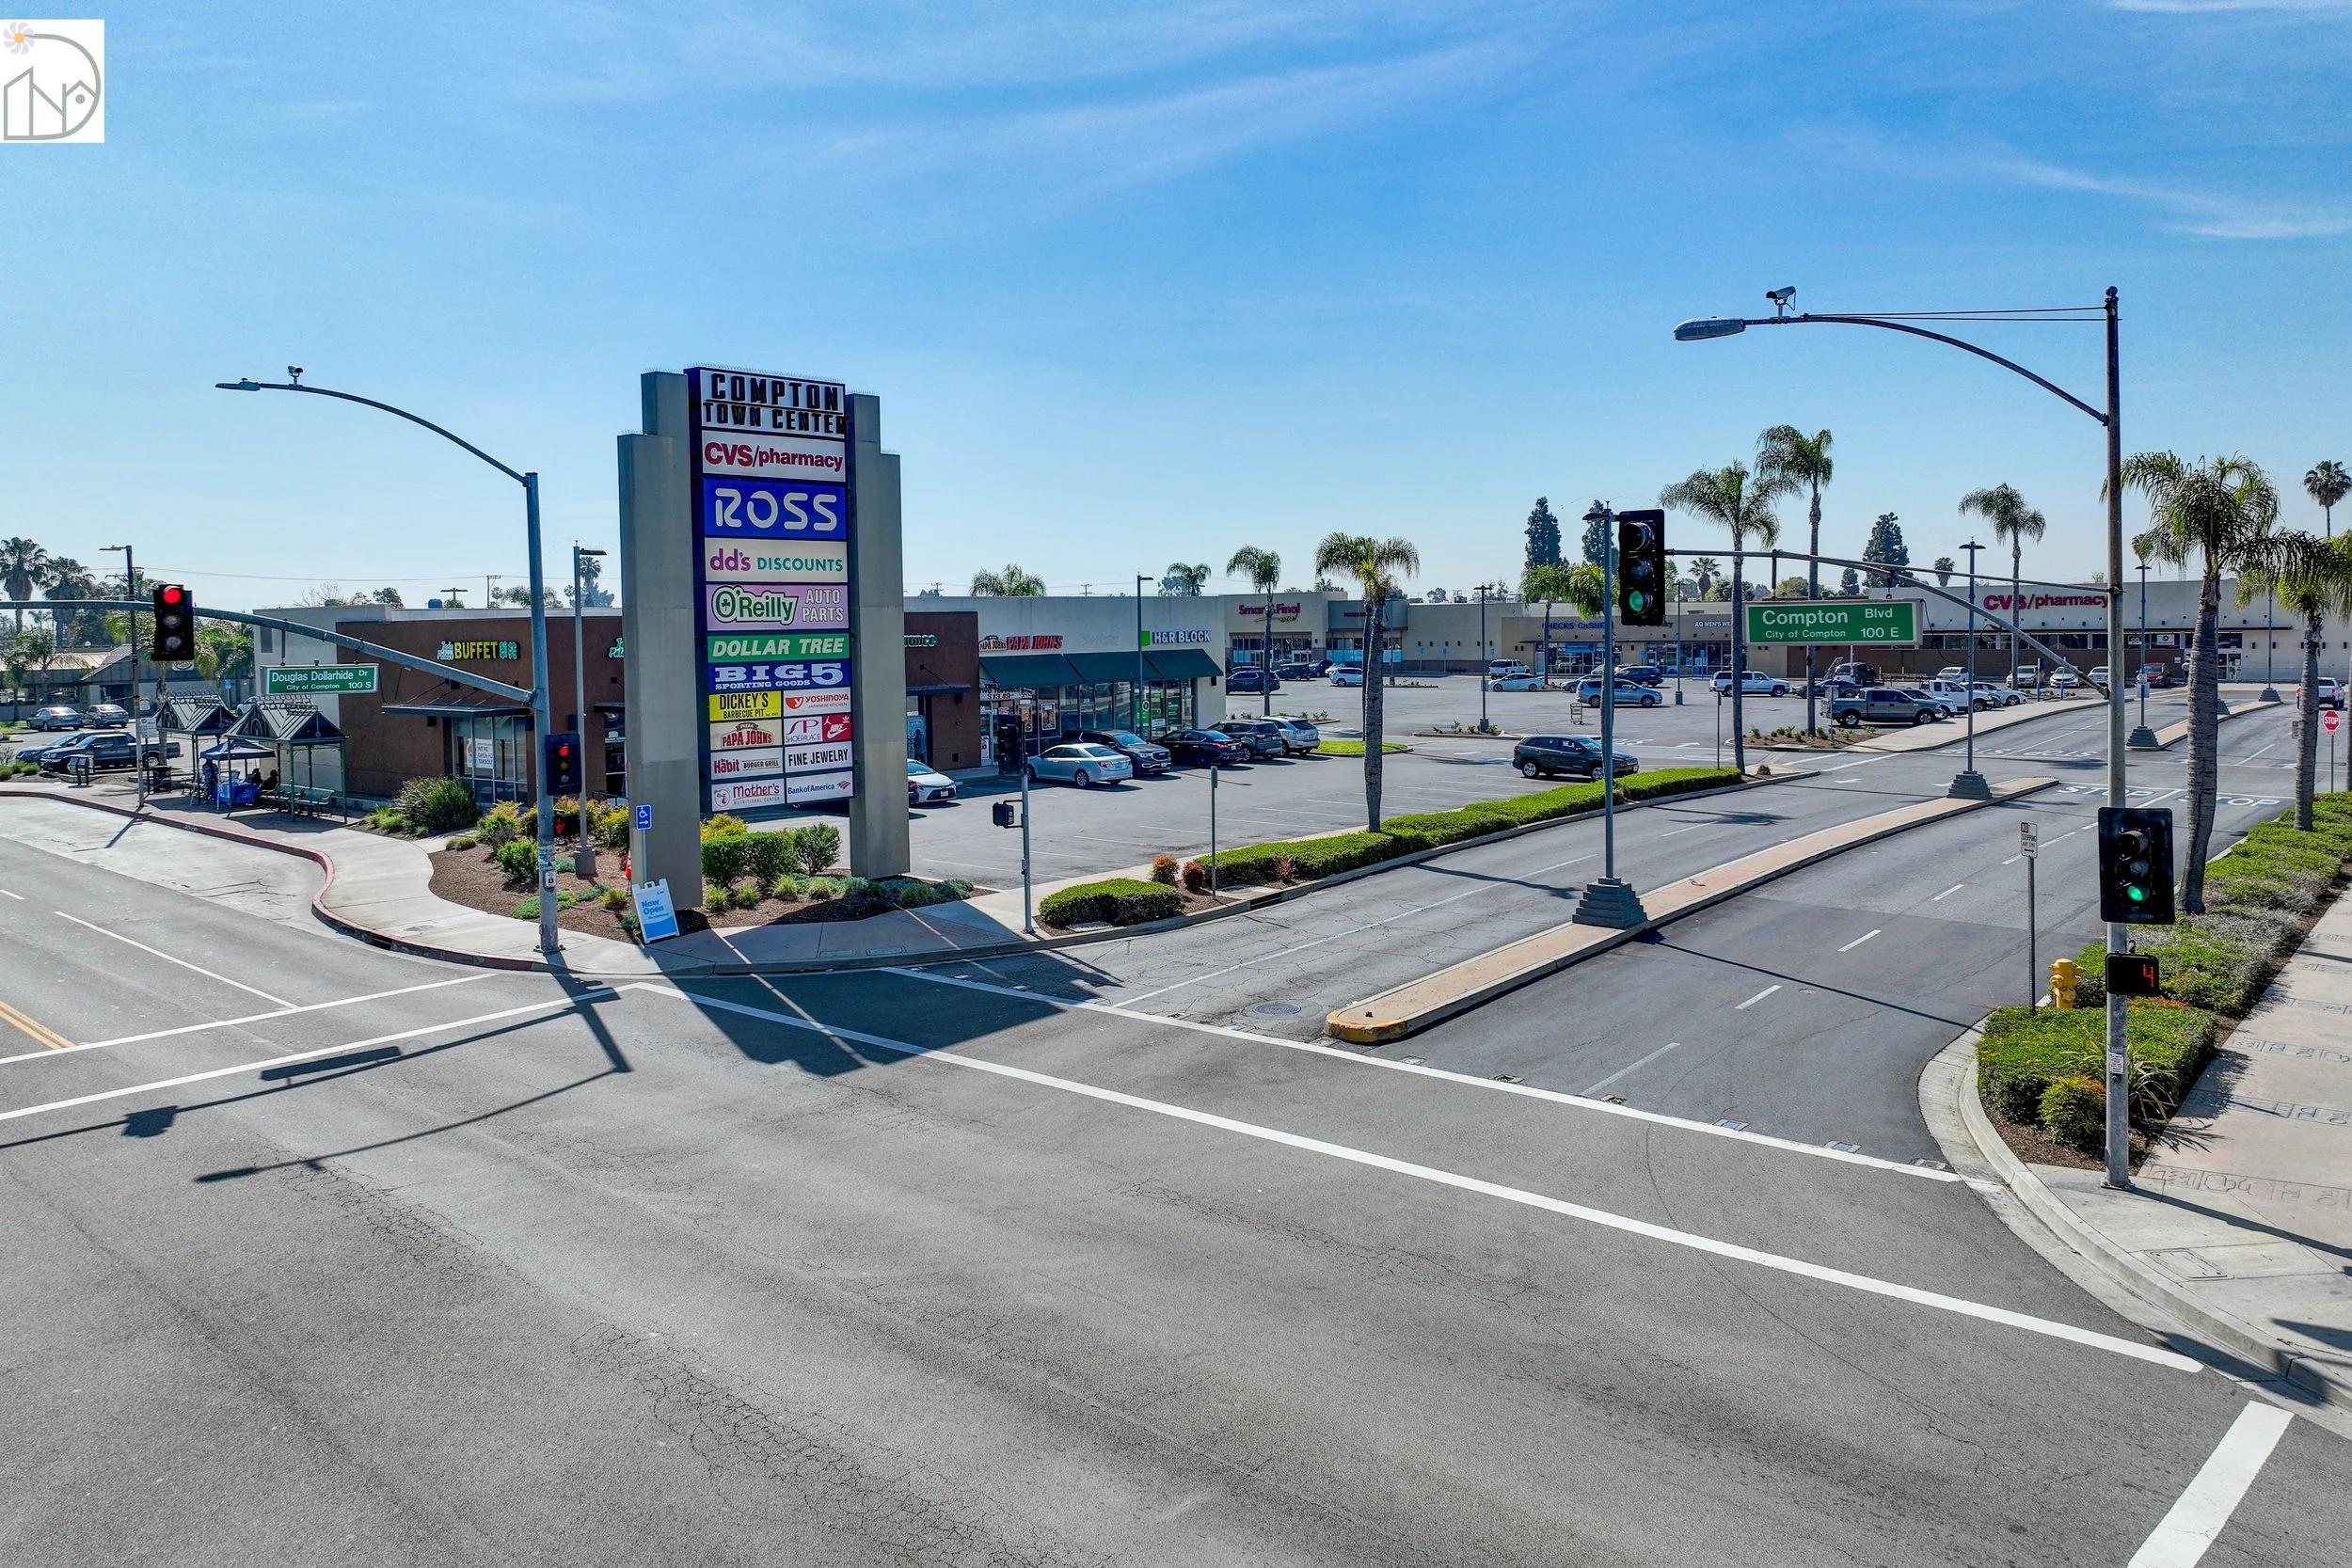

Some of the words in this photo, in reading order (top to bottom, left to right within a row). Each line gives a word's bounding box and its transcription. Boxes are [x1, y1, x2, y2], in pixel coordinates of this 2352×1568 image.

[711, 372, 839, 411] COMPTON
[703, 402, 762, 427] TOWN
[771, 407, 847, 435] CENTER
[705, 442, 844, 472] CVS/pharmacy
[715, 487, 838, 531] ROSS
[709, 547, 752, 572] dd's
[756, 557, 844, 572] DISCOUNTS
[805, 589, 840, 605] AUTO
[715, 590, 794, 622] O'Reilly
[1865, 608, 1893, 619] Blvd
[802, 607, 845, 623] PARTS
[1762, 610, 1849, 627] Compton
[1152, 631, 1177, 644] H&R
[1178, 630, 1211, 642] BLOCK
[1765, 629, 1785, 640] City
[1788, 629, 1799, 639] of
[1802, 629, 1847, 640] Compton
[1860, 627, 1884, 639] 100
[1890, 627, 1899, 638] E
[453, 641, 498, 659] BUFFET
[712, 640, 790, 657] DOLLAR
[800, 638, 845, 654] TREE
[1007, 636, 1031, 650] PAPA
[271, 672, 309, 684] Douglas
[310, 670, 354, 681] Dollarhide
[715, 664, 808, 683] BIG
[811, 662, 844, 686] 5
[715, 681, 772, 690] SPORTING
[775, 679, 811, 688] GOODS
[720, 692, 769, 710] DICKEY'S
[723, 709, 754, 720] BARBECUE
[755, 708, 765, 718] PIT
[2324, 717, 2339, 725] STOP
[723, 731, 744, 747] PAPA
[745, 730, 772, 746] JOHNS
[788, 752, 808, 767] FINE
[810, 749, 849, 765] JEWELRY
[713, 759, 740, 774] Habit
[787, 786, 803, 795] Bank
[810, 784, 835, 792] America
[641, 899, 660, 909] Now
[643, 906, 664, 915] Open
[2142, 963, 2154, 988] 4
